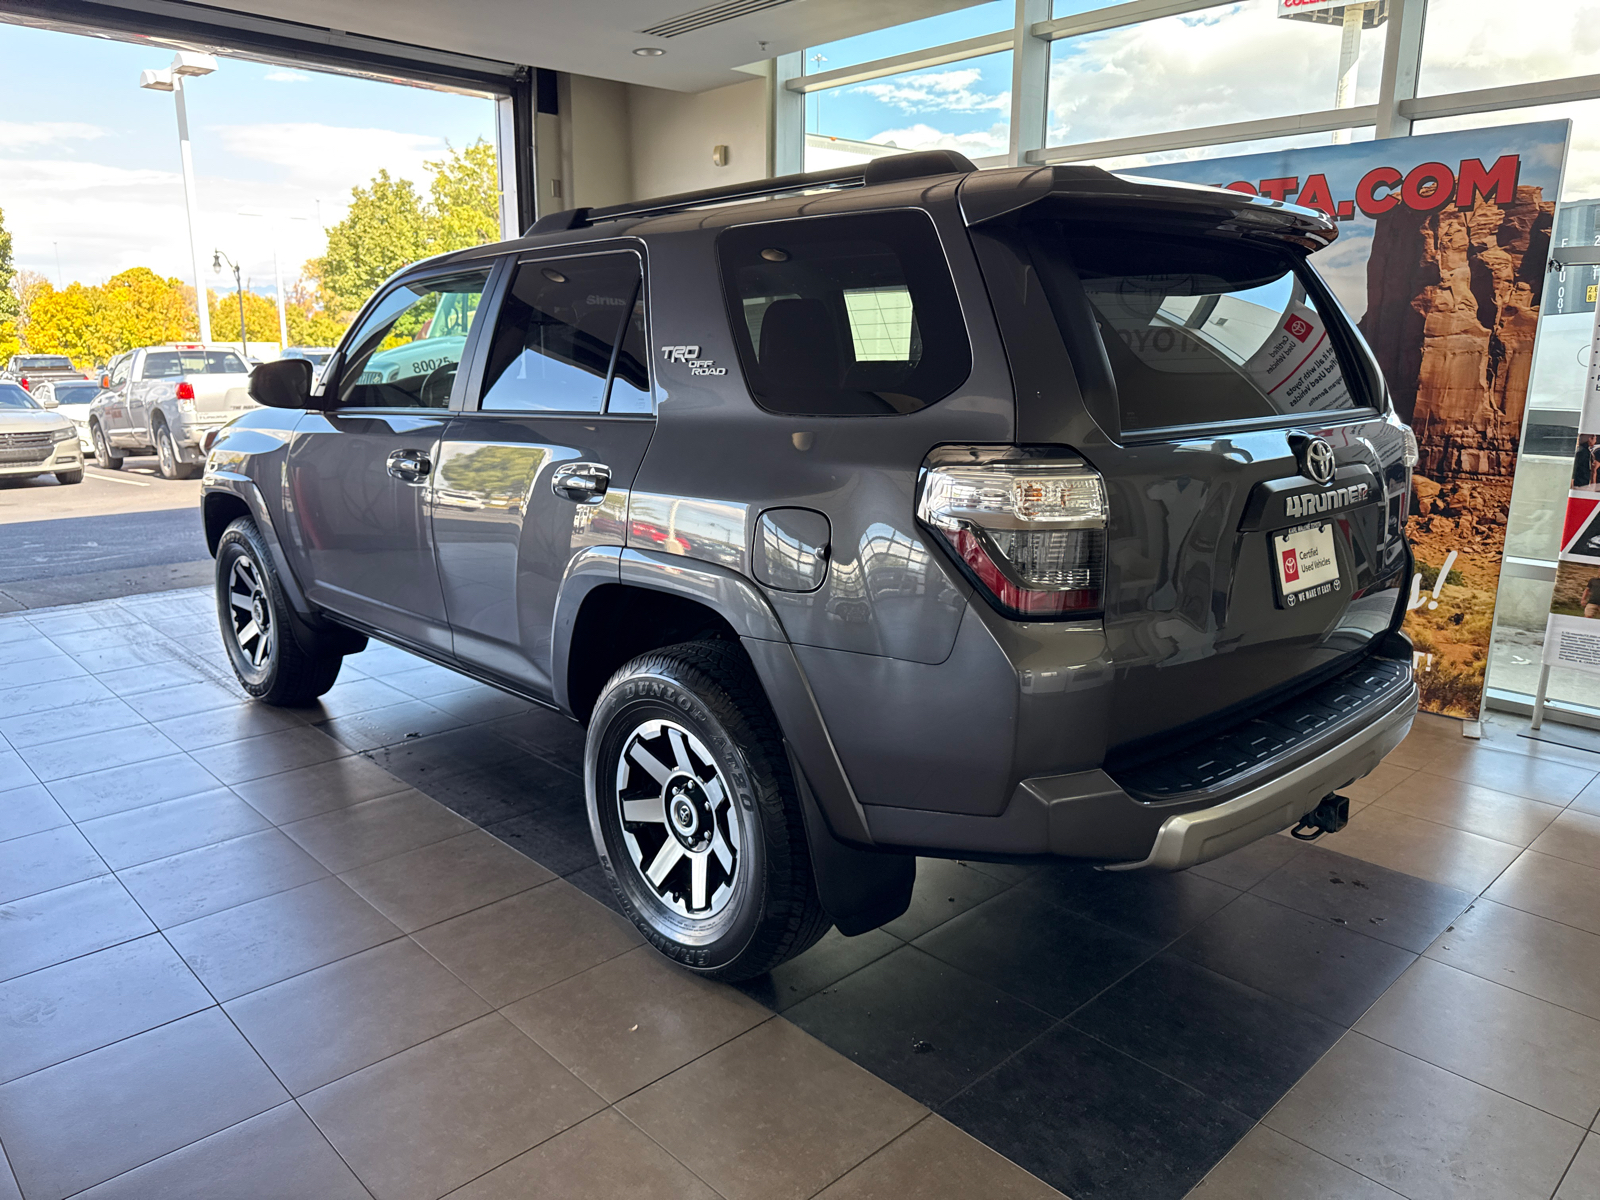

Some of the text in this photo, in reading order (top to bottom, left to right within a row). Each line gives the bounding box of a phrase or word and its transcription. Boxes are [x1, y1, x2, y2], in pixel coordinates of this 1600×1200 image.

[1208, 155, 1522, 221] TA.COM
[586, 294, 627, 306] Sirius
[661, 345, 700, 364] TRD
[688, 360, 714, 368] OFF
[691, 367, 726, 376] ROAD
[1286, 483, 1369, 518] 4RUNNER
[1299, 547, 1319, 560] Certified
[1301, 557, 1331, 573] Used Vehicles
[1298, 592, 1306, 602] WE
[1305, 588, 1317, 600] MAKE
[625, 680, 708, 722] DUNLOP
